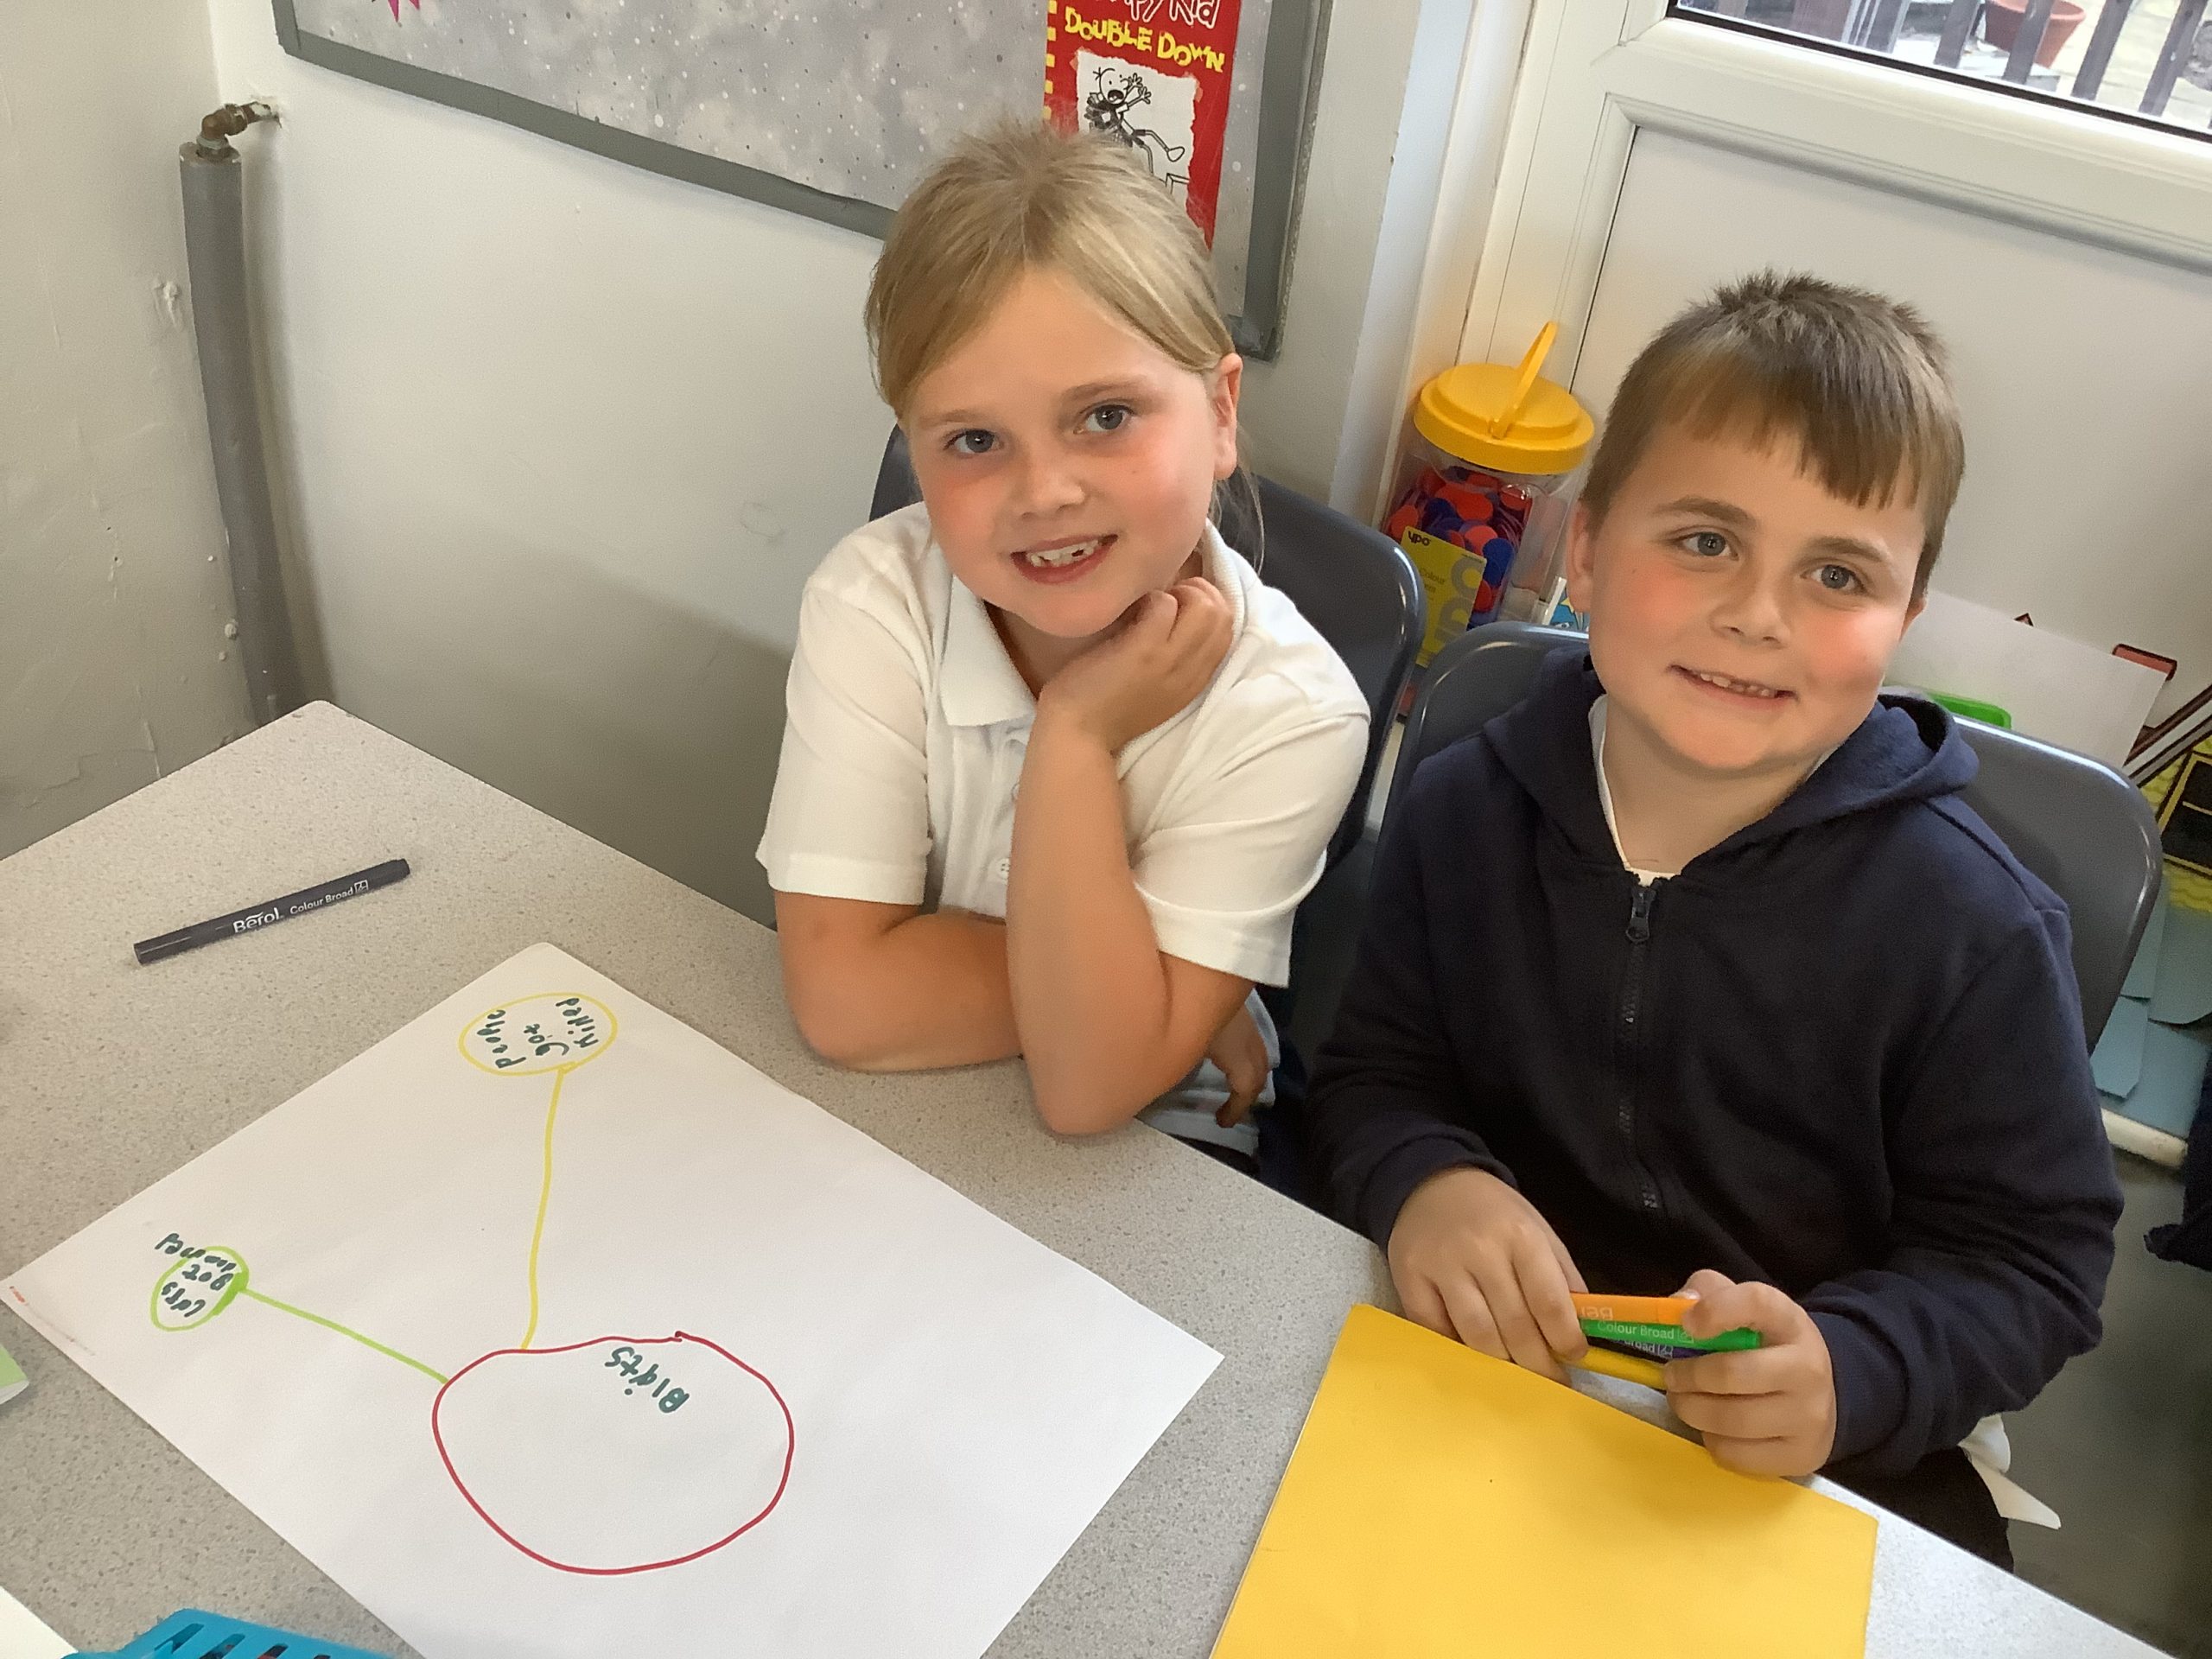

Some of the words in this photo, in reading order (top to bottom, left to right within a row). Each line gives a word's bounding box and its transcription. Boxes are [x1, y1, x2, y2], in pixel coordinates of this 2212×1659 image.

[1065, 6, 1153, 52] DOUBLE
[1157, 31, 1225, 73] DOWN
[232, 906, 280, 933] Berol
[289, 898, 324, 915] Colour
[325, 887, 354, 904] Broad
[1597, 1320, 1637, 1335] Colour
[1640, 1325, 1675, 1339] Broad
